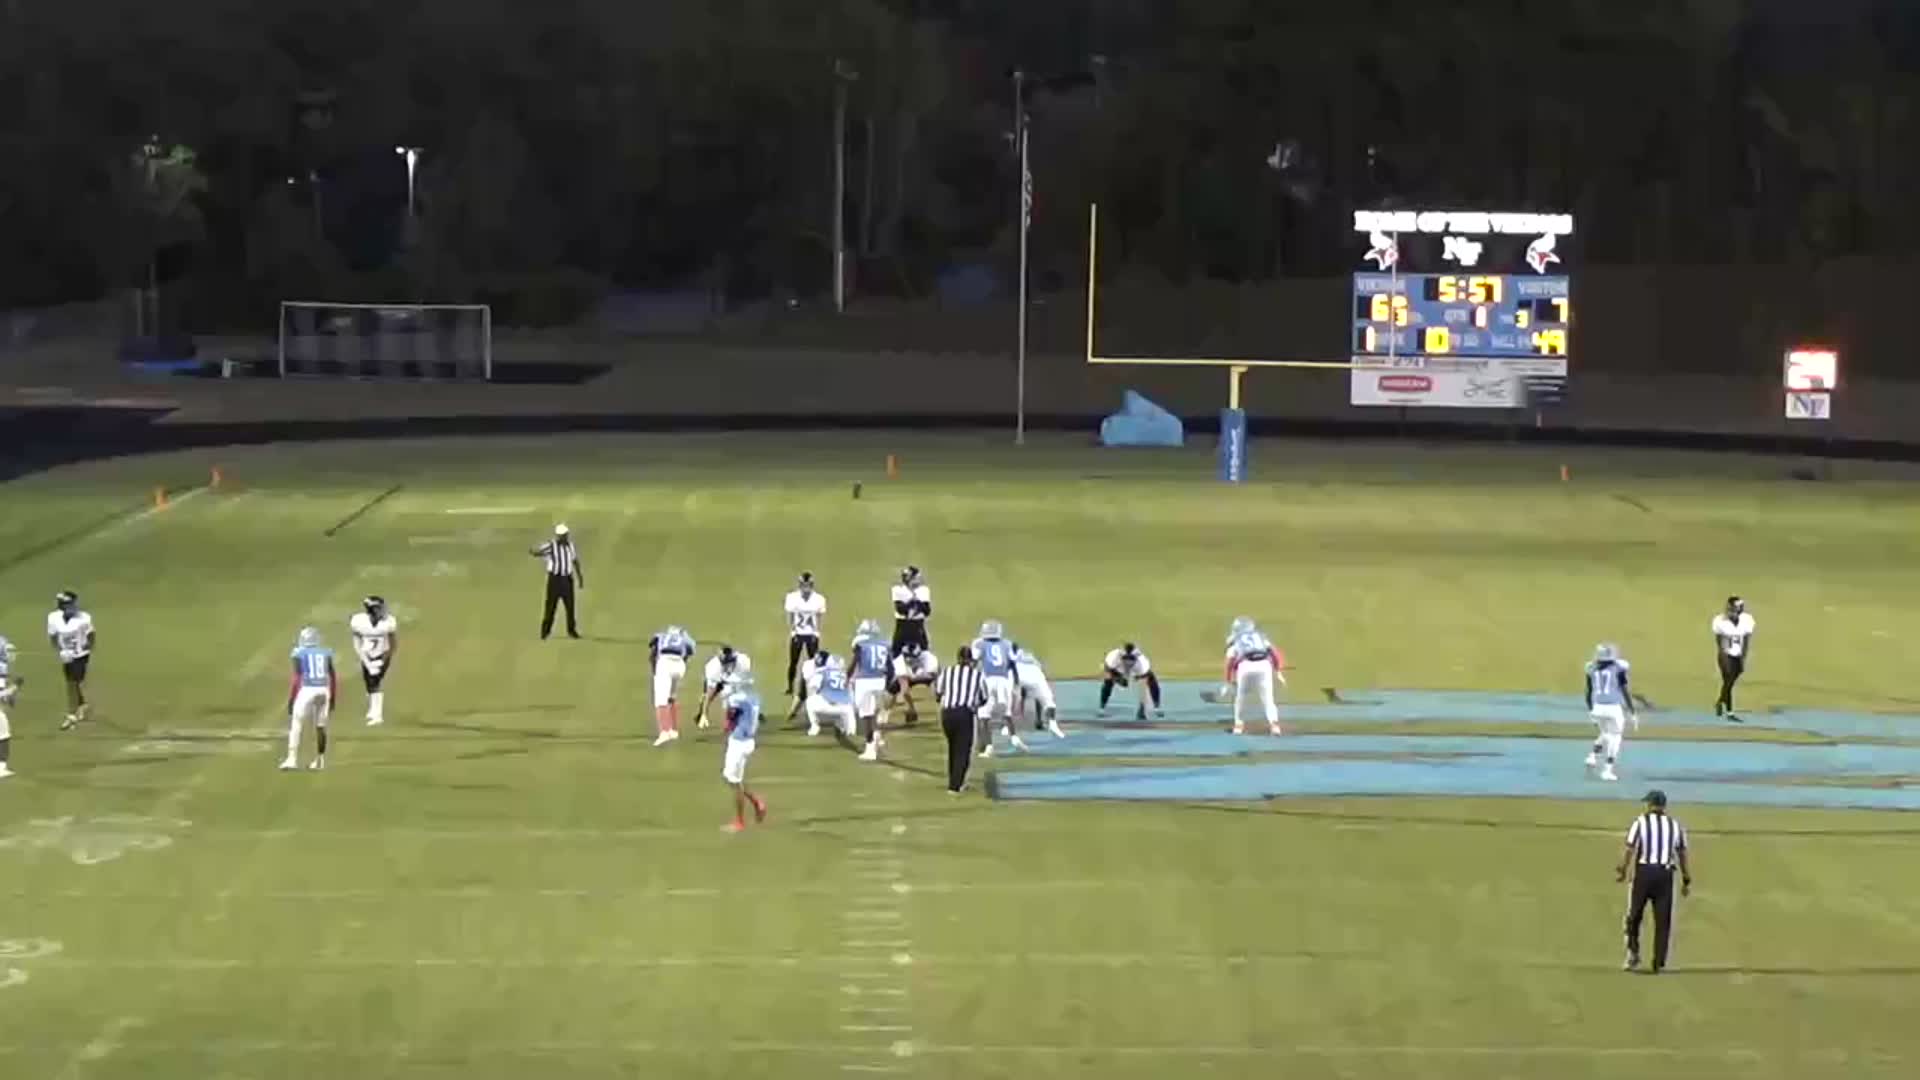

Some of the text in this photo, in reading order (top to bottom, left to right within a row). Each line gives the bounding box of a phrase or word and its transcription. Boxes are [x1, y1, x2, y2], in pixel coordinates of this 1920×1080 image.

[1439, 275, 1502, 304] 5:57
[1514, 309, 1528, 329] 3
[1550, 297, 1567, 323] 7
[797, 612, 814, 629] 24
[308, 653, 325, 679] 18
[871, 645, 888, 669] 15
[991, 644, 1003, 667] 9
[1594, 670, 1611, 695] 17
